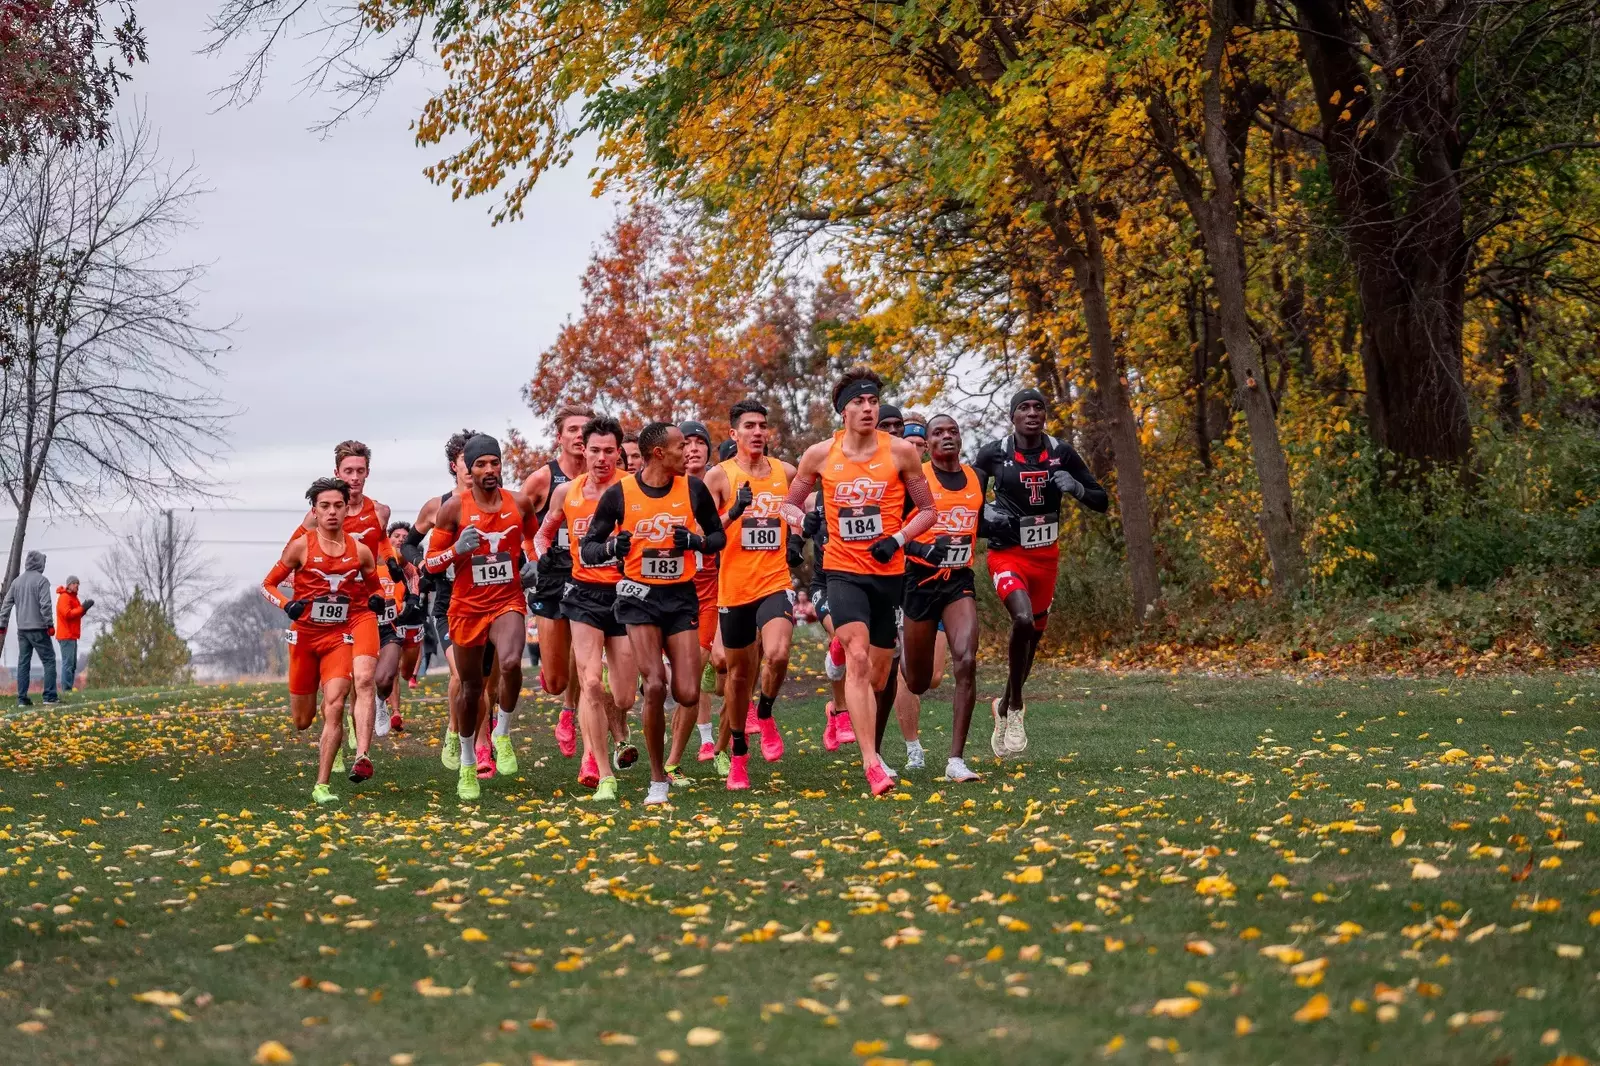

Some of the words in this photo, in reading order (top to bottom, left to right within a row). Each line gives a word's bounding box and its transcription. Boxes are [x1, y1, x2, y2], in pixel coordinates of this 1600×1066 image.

[834, 477, 887, 506] OSU
[845, 518, 876, 535] 184
[1026, 526, 1052, 542] 211
[748, 529, 776, 544] 180
[479, 564, 507, 580] 194
[648, 560, 678, 574] 183
[620, 582, 643, 597] 183
[318, 604, 343, 618] 198
